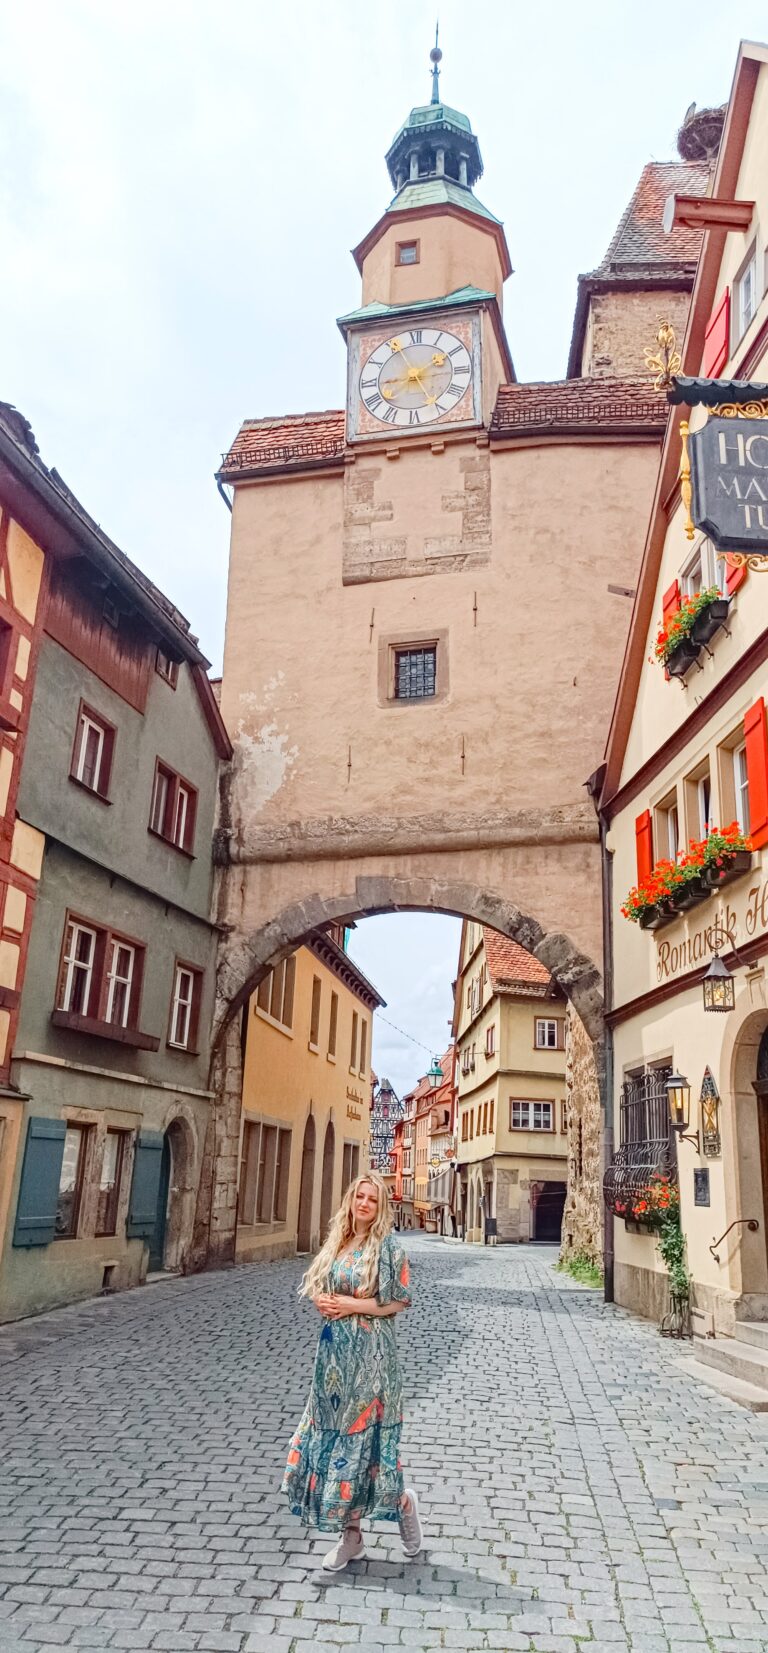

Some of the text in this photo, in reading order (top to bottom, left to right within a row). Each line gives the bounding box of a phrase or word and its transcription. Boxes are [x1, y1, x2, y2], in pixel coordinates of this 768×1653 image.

[409, 331, 422, 344] XII
[434, 333, 443, 345] I
[449, 344, 463, 356] II
[368, 358, 383, 368] X
[454, 365, 470, 374] III
[362, 379, 376, 388] IX
[447, 383, 465, 397] IIII
[365, 393, 383, 412] VIII
[382, 406, 398, 422] VII
[434, 403, 447, 415] V
[409, 410, 420, 424] VI
[656, 905, 737, 982] Romantik
